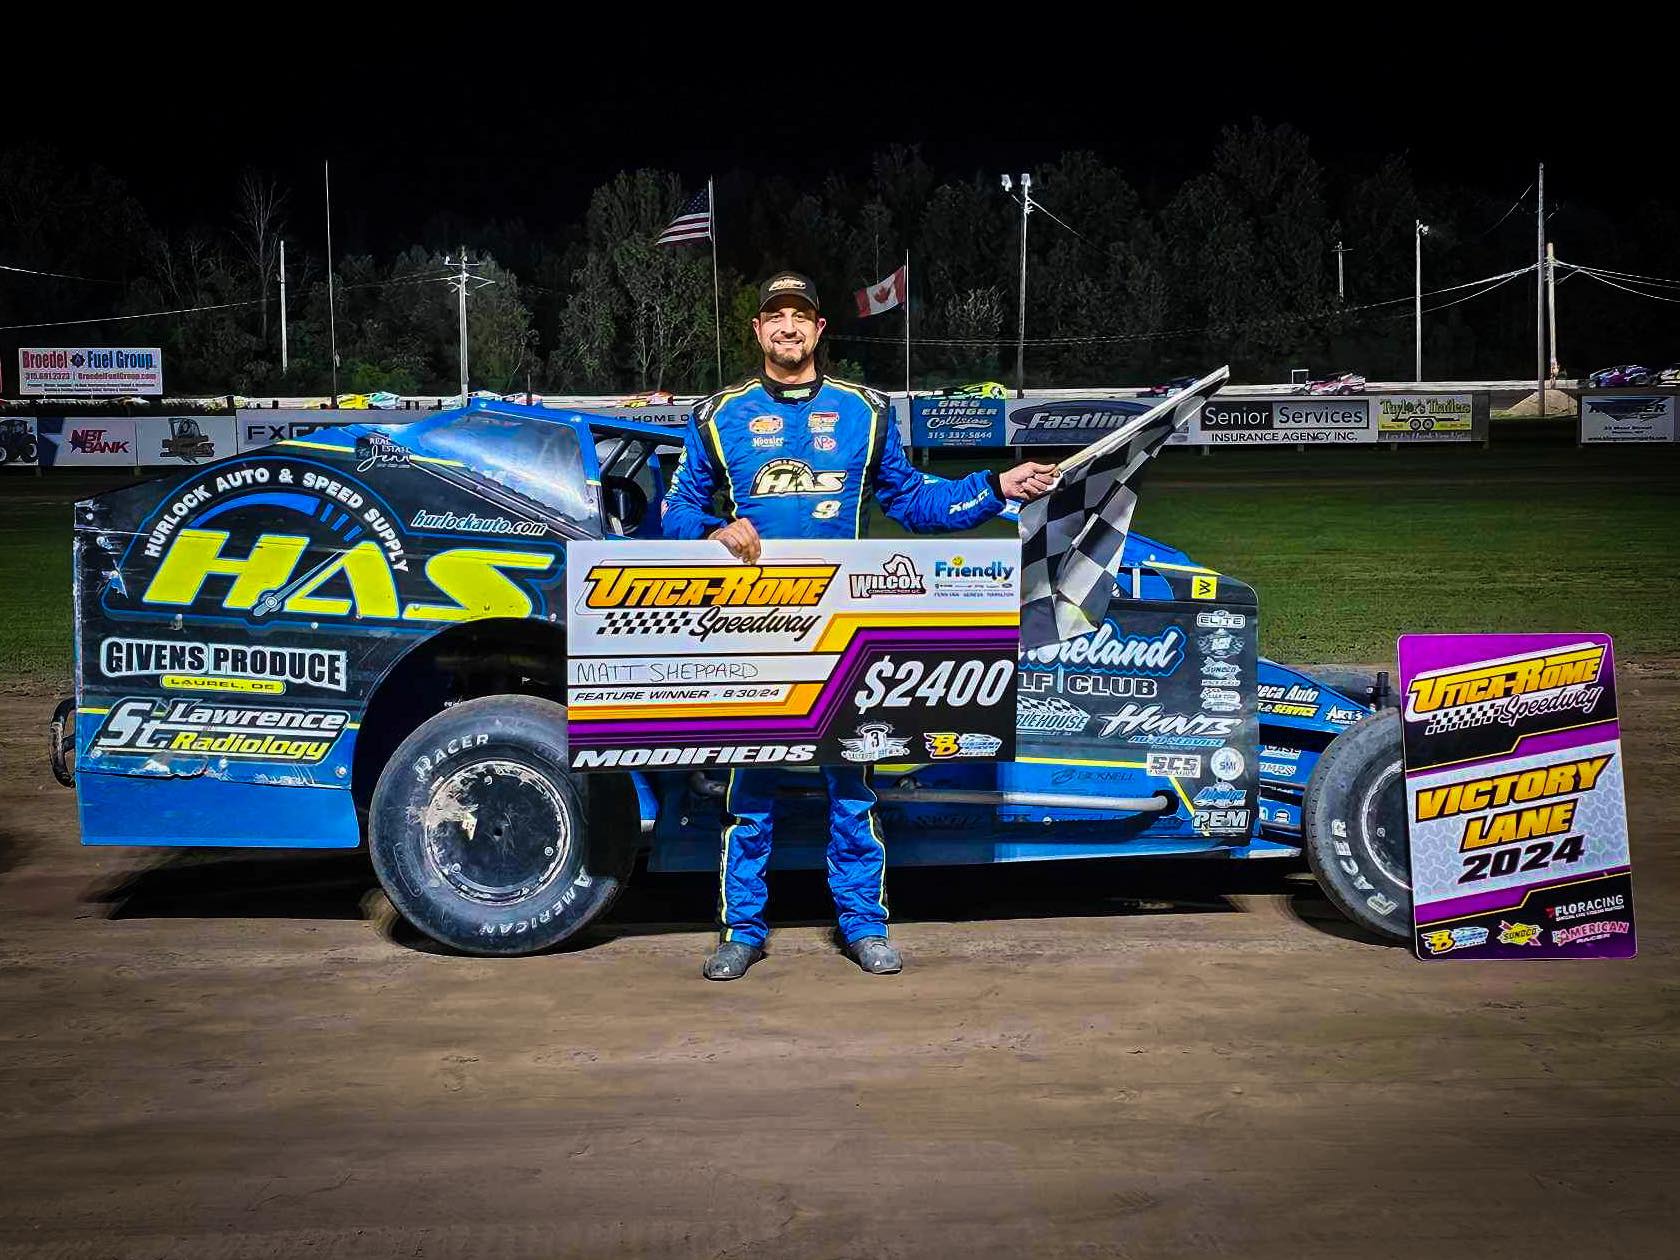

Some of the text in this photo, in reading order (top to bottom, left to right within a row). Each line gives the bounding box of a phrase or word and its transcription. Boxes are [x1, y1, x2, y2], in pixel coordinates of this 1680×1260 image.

[22, 350, 68, 369] Broedel
[87, 350, 114, 369] Fuel
[632, 414, 676, 424] HOME
[921, 408, 998, 416] ELLINGER
[1205, 405, 1363, 426] Senior Services
[71, 429, 107, 442] NBT
[80, 441, 130, 454] BANK
[1211, 432, 1279, 442] INSURANCE
[1281, 432, 1332, 442] AGENCY
[756, 471, 848, 495] HAS
[144, 467, 410, 573] HURLOCK AUTO & SPEED SUPPLY
[812, 500, 842, 519] 9
[410, 509, 549, 537] hurlockauto.com
[142, 528, 556, 622] HAS
[934, 559, 1015, 581] Friendly
[584, 564, 842, 609] UTICA-ROME
[849, 574, 925, 599] WILCOX
[688, 605, 822, 643] Speedway
[105, 640, 343, 686] GIVENS PRODUCE
[576, 661, 759, 684] MATT SHEPPARD
[170, 678, 275, 691] LAUREL, DE
[854, 655, 1015, 716] $2400
[1067, 674, 1157, 698] CLUB
[1407, 644, 1606, 715] UTICA-ROME
[575, 690, 645, 702] FEATURE
[649, 689, 710, 701] WINNER
[1284, 684, 1320, 702] Auto
[166, 701, 347, 730] Lawrence
[1272, 704, 1318, 717] SERVICE
[1498, 685, 1604, 727] Speedway
[170, 731, 331, 760] Radiology
[412, 733, 490, 781] RACER
[571, 744, 818, 769] MODIFIEDS
[1151, 756, 1198, 770] SCS
[1415, 753, 1616, 823] VICTORY
[1458, 799, 1582, 854] LANE
[1331, 818, 1399, 917] RACER
[1457, 835, 1586, 885] 2024
[478, 865, 593, 937] AMERICAN
[1555, 894, 1625, 917] FLORACING
[1502, 927, 1539, 940] SUNOCO
[1558, 921, 1630, 947] AMERICAN
